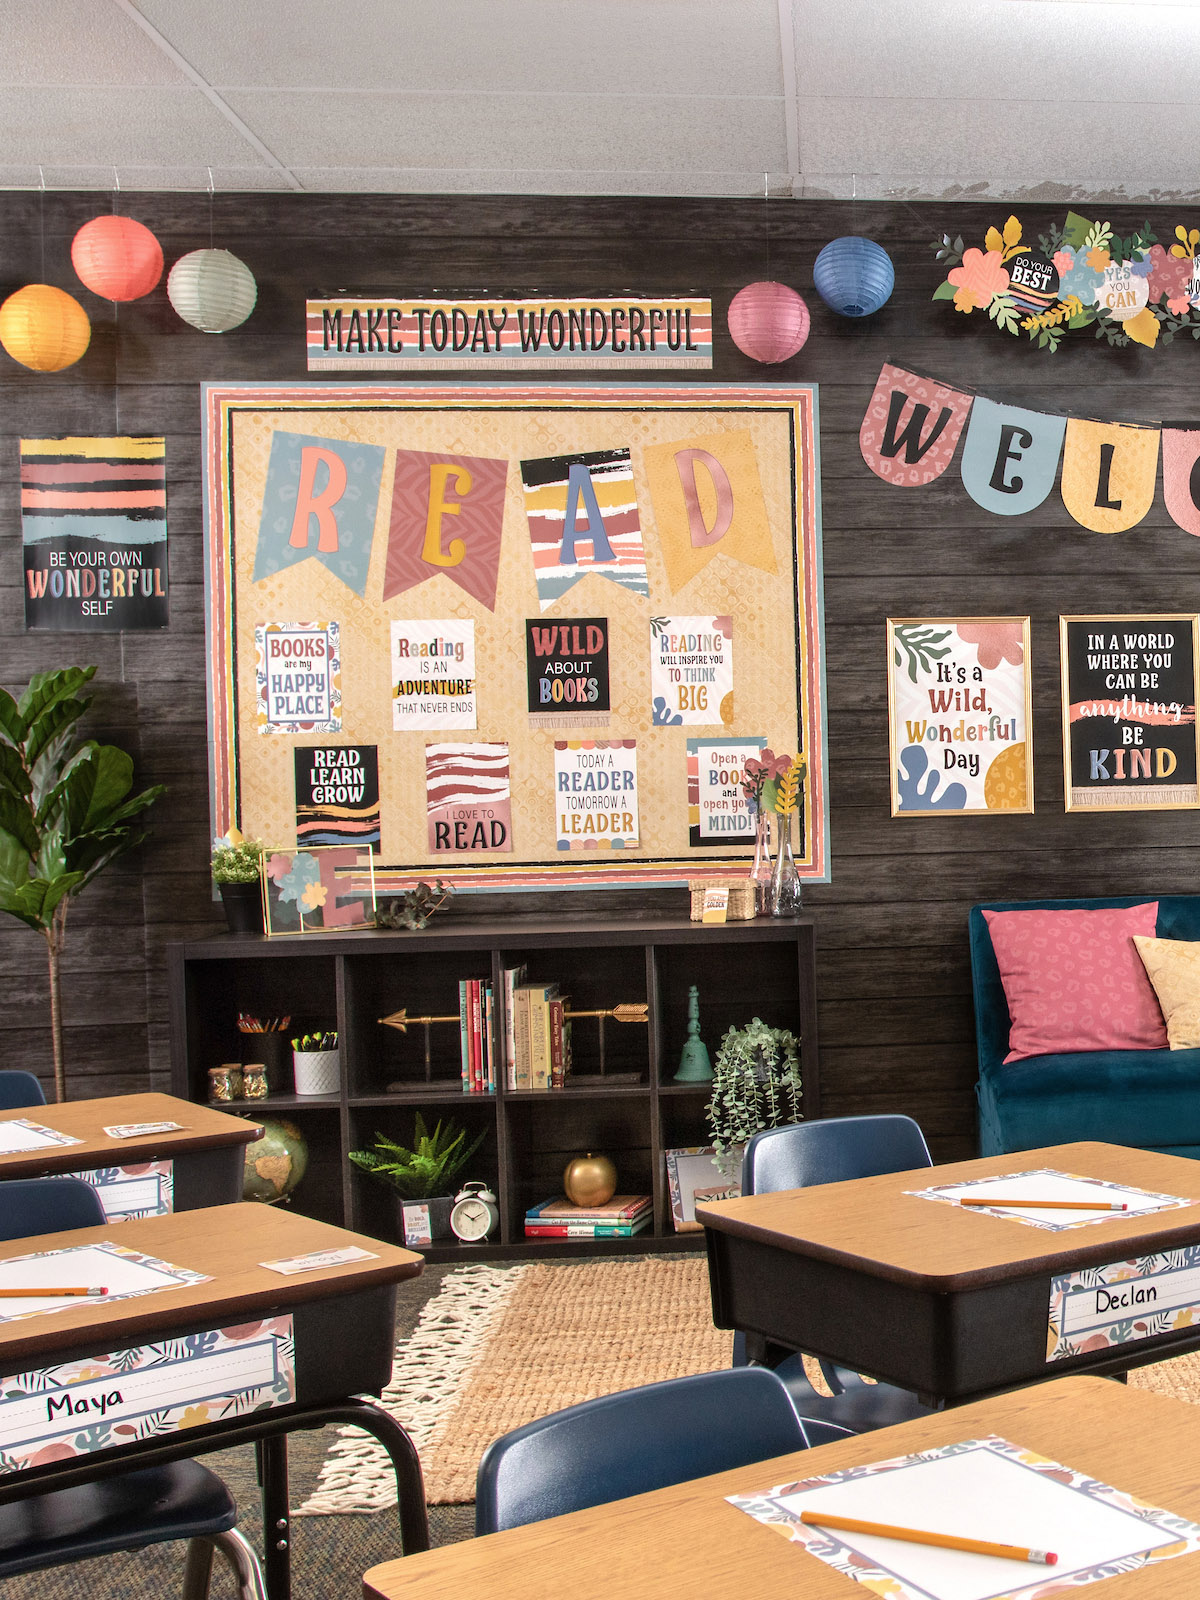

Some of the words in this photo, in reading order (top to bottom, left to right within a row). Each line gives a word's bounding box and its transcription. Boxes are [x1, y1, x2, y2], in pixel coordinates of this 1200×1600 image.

[1016, 257, 1028, 266] DO
[1030, 260, 1053, 274] YOUR
[1105, 267, 1130, 280] YES
[1011, 266, 1051, 291] BEST
[1110, 281, 1129, 291] YOU
[1106, 292, 1137, 308] CAN
[323, 308, 402, 354] MAKE
[412, 308, 508, 353] TODAY
[517, 308, 699, 353] WONDERFUL
[288, 446, 734, 567] READ
[50, 552, 65, 566] BE
[70, 551, 106, 566] YOUR
[110, 551, 142, 566] OWN
[27, 568, 165, 599] WONDERFUL
[82, 601, 113, 616] SELF
[270, 638, 325, 658] BOOKS
[398, 637, 464, 661] Reading
[531, 625, 604, 656] WILD
[661, 634, 722, 653] READING
[1088, 635, 1105, 650] IN
[1109, 635, 1119, 649] A
[1123, 633, 1174, 650] WORLD
[545, 662, 592, 674] ABOUT
[1087, 654, 1138, 670] WHERE
[1143, 653, 1172, 669] YOU
[669, 668, 681, 682] TO
[684, 667, 715, 682] THINK
[936, 662, 966, 683] It's
[973, 668, 983, 682] a
[1105, 674, 1135, 689] CAN
[1140, 673, 1159, 688] BE
[272, 674, 325, 693] HAPPY
[397, 679, 472, 695] ADVENTURE
[539, 677, 598, 703] BOOKS
[275, 696, 323, 715] PLACE
[678, 685, 707, 711] BIG
[928, 688, 993, 714] Wild,
[1080, 694, 1184, 724] anything
[906, 715, 1017, 743] Wonderful
[1122, 726, 1143, 744] BE
[315, 750, 360, 767] READ
[944, 749, 980, 776] Day
[1089, 748, 1177, 780] KIND
[310, 768, 365, 785] LEARN
[558, 771, 634, 792] READER
[312, 786, 364, 803] GROW
[722, 788, 737, 797] and
[561, 813, 633, 834] LEADER
[709, 815, 751, 831] MIND!
[435, 819, 506, 850] READ
[1096, 1285, 1157, 1314] Declan
[47, 1390, 123, 1422] Maya
